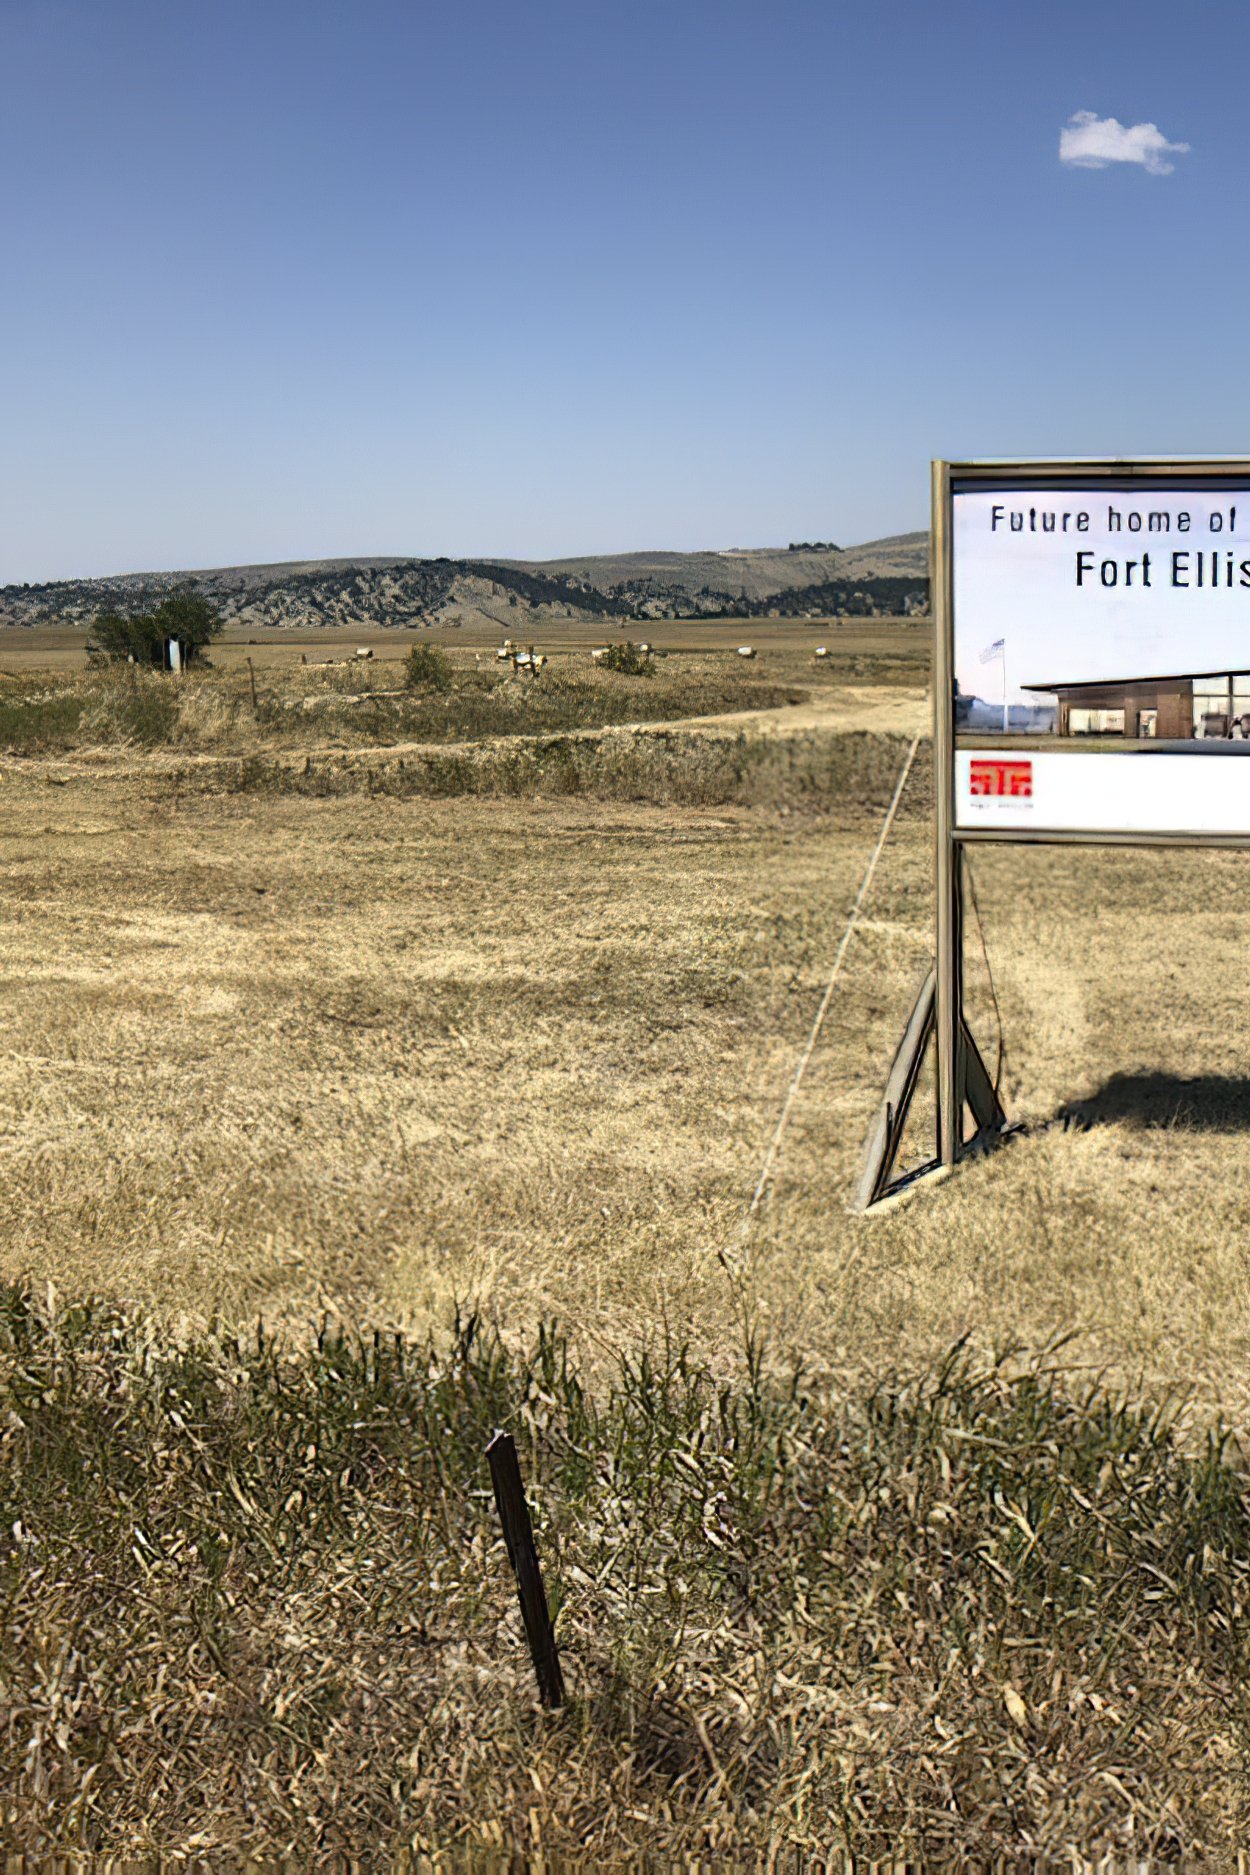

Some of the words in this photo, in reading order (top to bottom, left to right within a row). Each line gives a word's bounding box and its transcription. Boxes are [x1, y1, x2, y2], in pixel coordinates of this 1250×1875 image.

[991, 505, 1090, 532] Future
[1107, 505, 1191, 532] home
[1208, 506, 1236, 532] of
[1075, 551, 1151, 587] Fort
